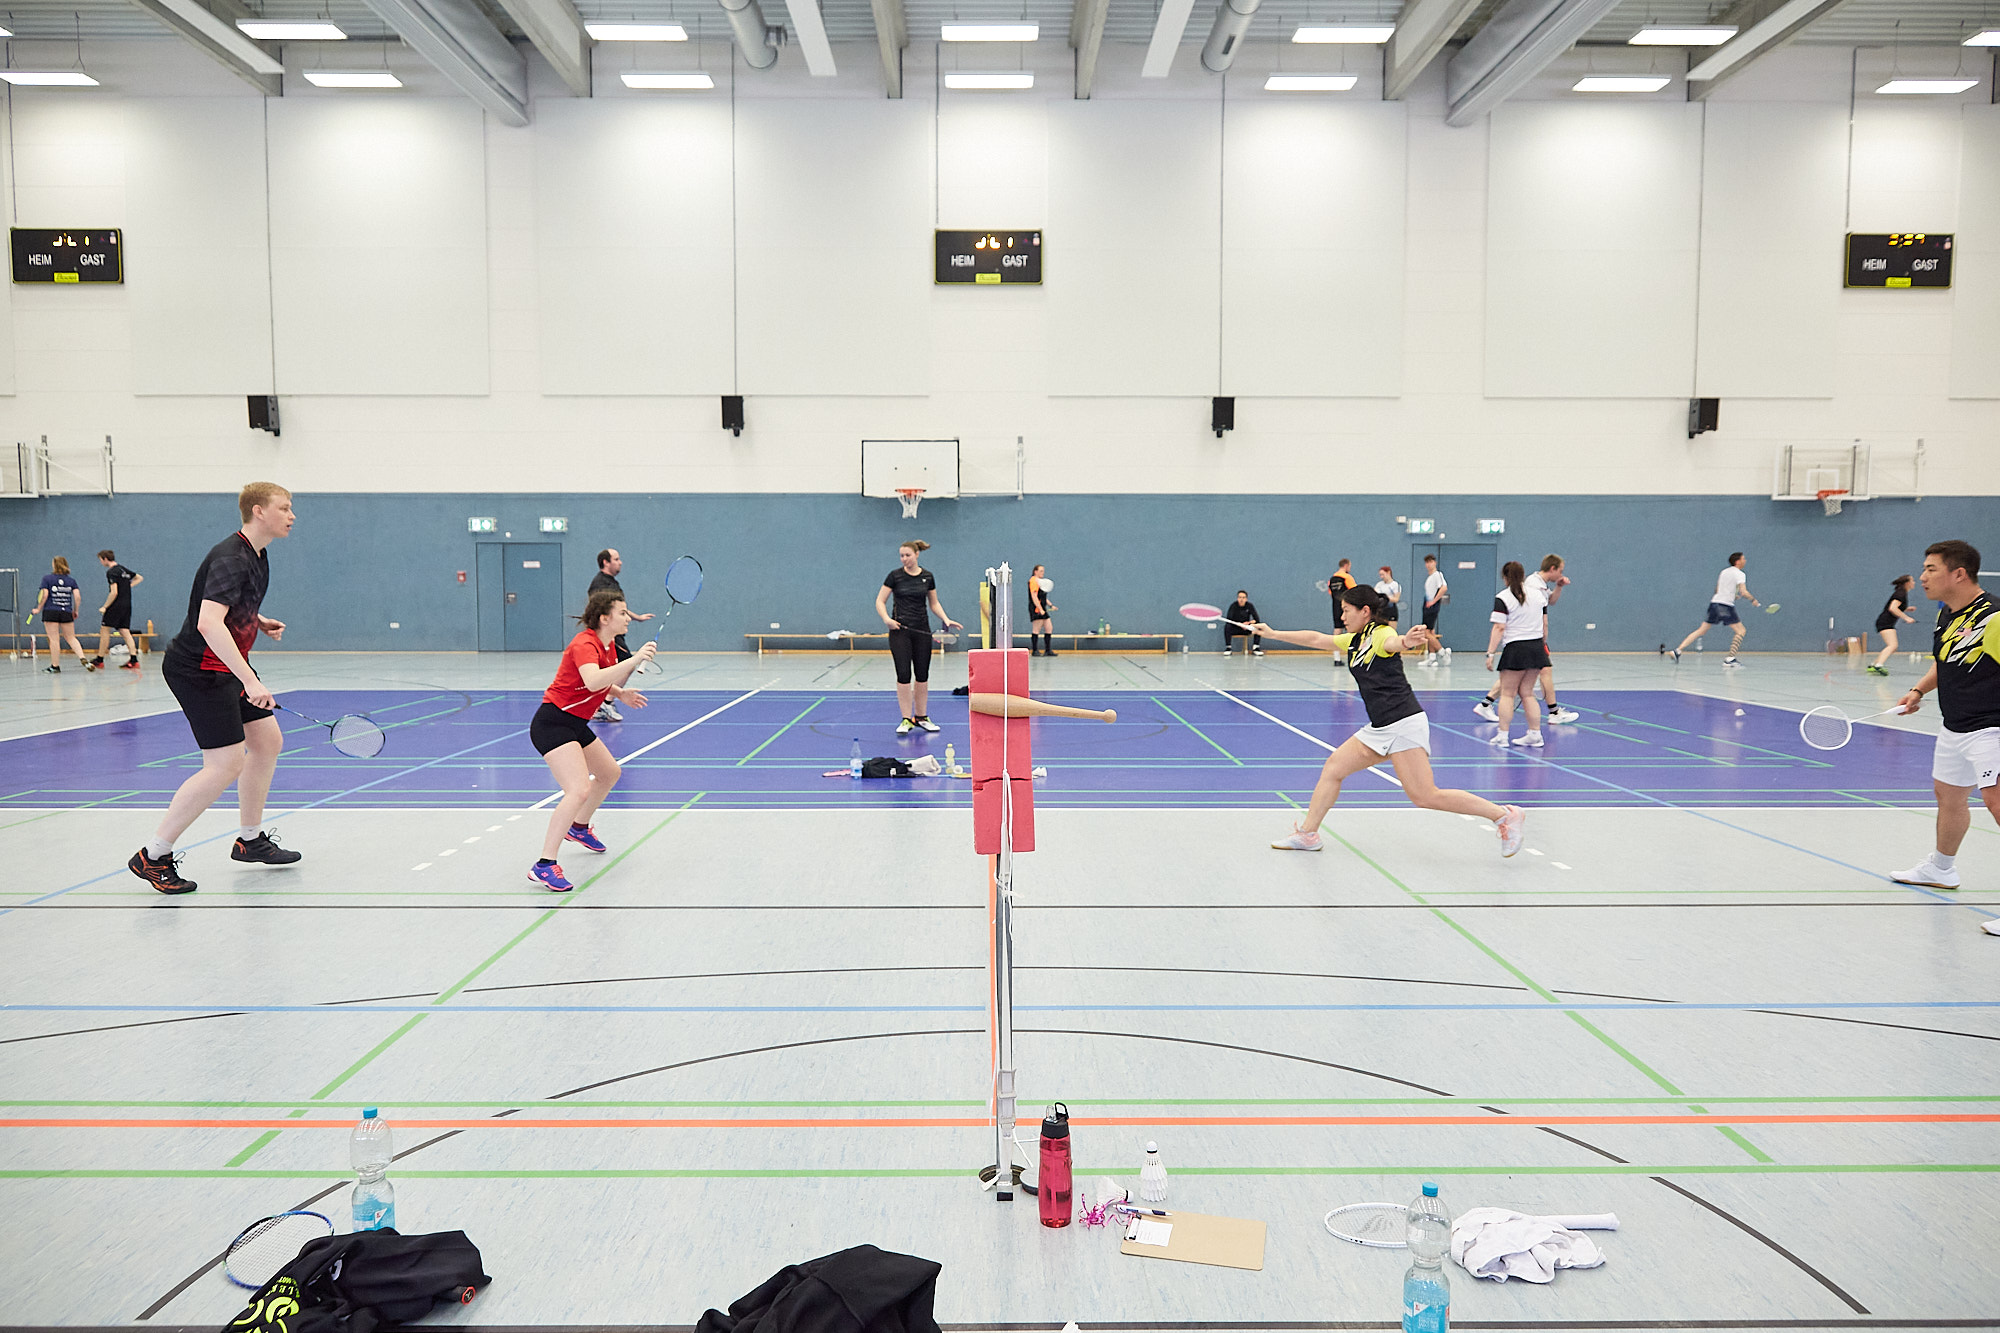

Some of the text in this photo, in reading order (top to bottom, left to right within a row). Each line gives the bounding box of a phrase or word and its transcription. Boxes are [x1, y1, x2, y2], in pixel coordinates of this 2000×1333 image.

[28, 253, 106, 266] HEIM GAST
[951, 254, 1028, 267] HEIM GAST
[1862, 258, 1939, 271] HEIM GAST
